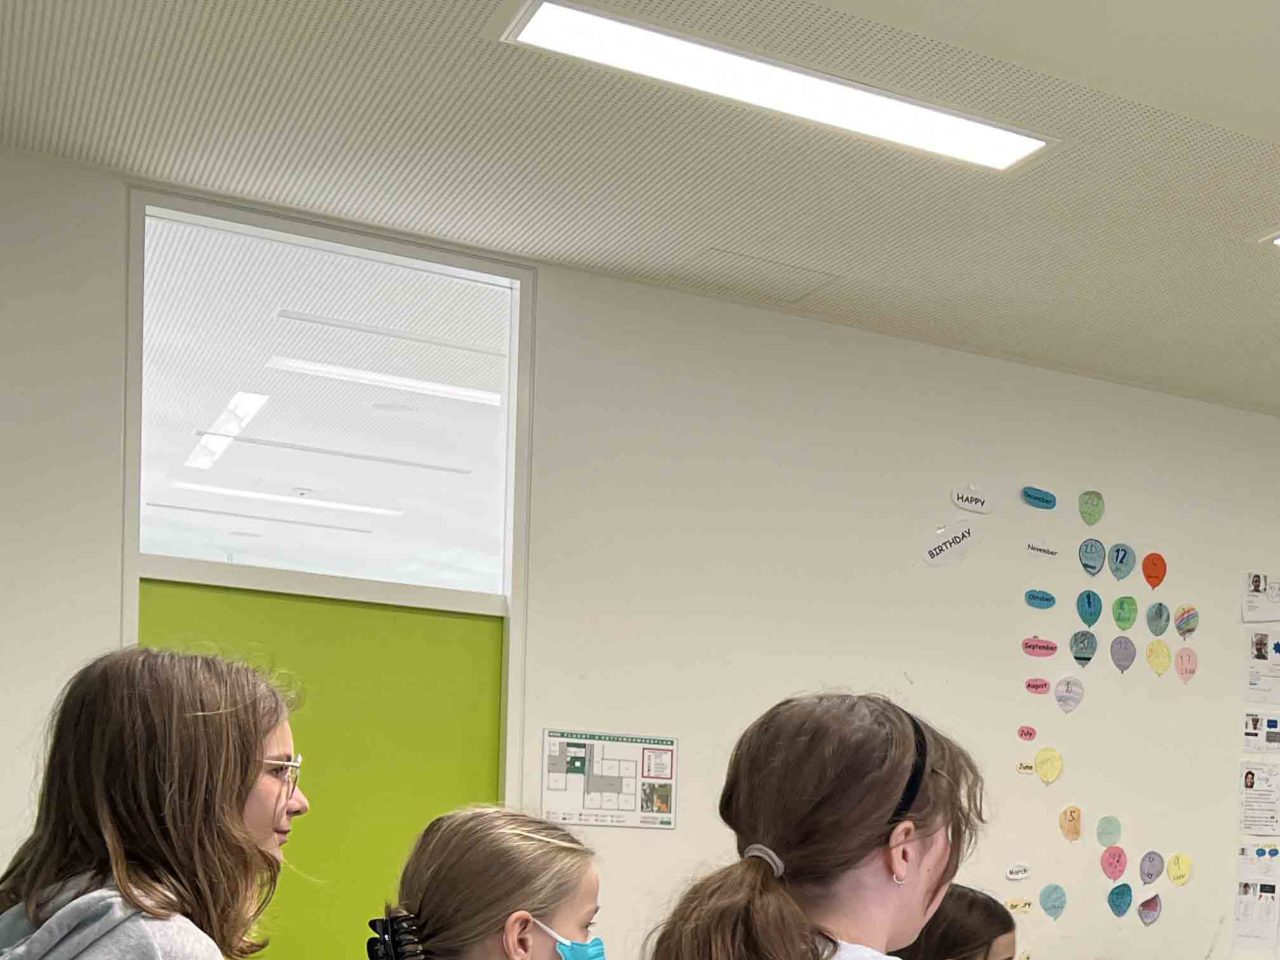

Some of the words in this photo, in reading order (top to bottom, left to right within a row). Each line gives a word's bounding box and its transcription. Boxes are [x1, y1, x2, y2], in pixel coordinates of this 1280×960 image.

[956, 493, 986, 507] HAPPY
[928, 528, 972, 560] BIRTHDAY
[1027, 543, 1058, 556] November
[1114, 548, 1128, 564] 12
[1024, 642, 1058, 652] September
[1025, 680, 1048, 691] August
[1019, 729, 1034, 739] July
[1018, 762, 1034, 771] June
